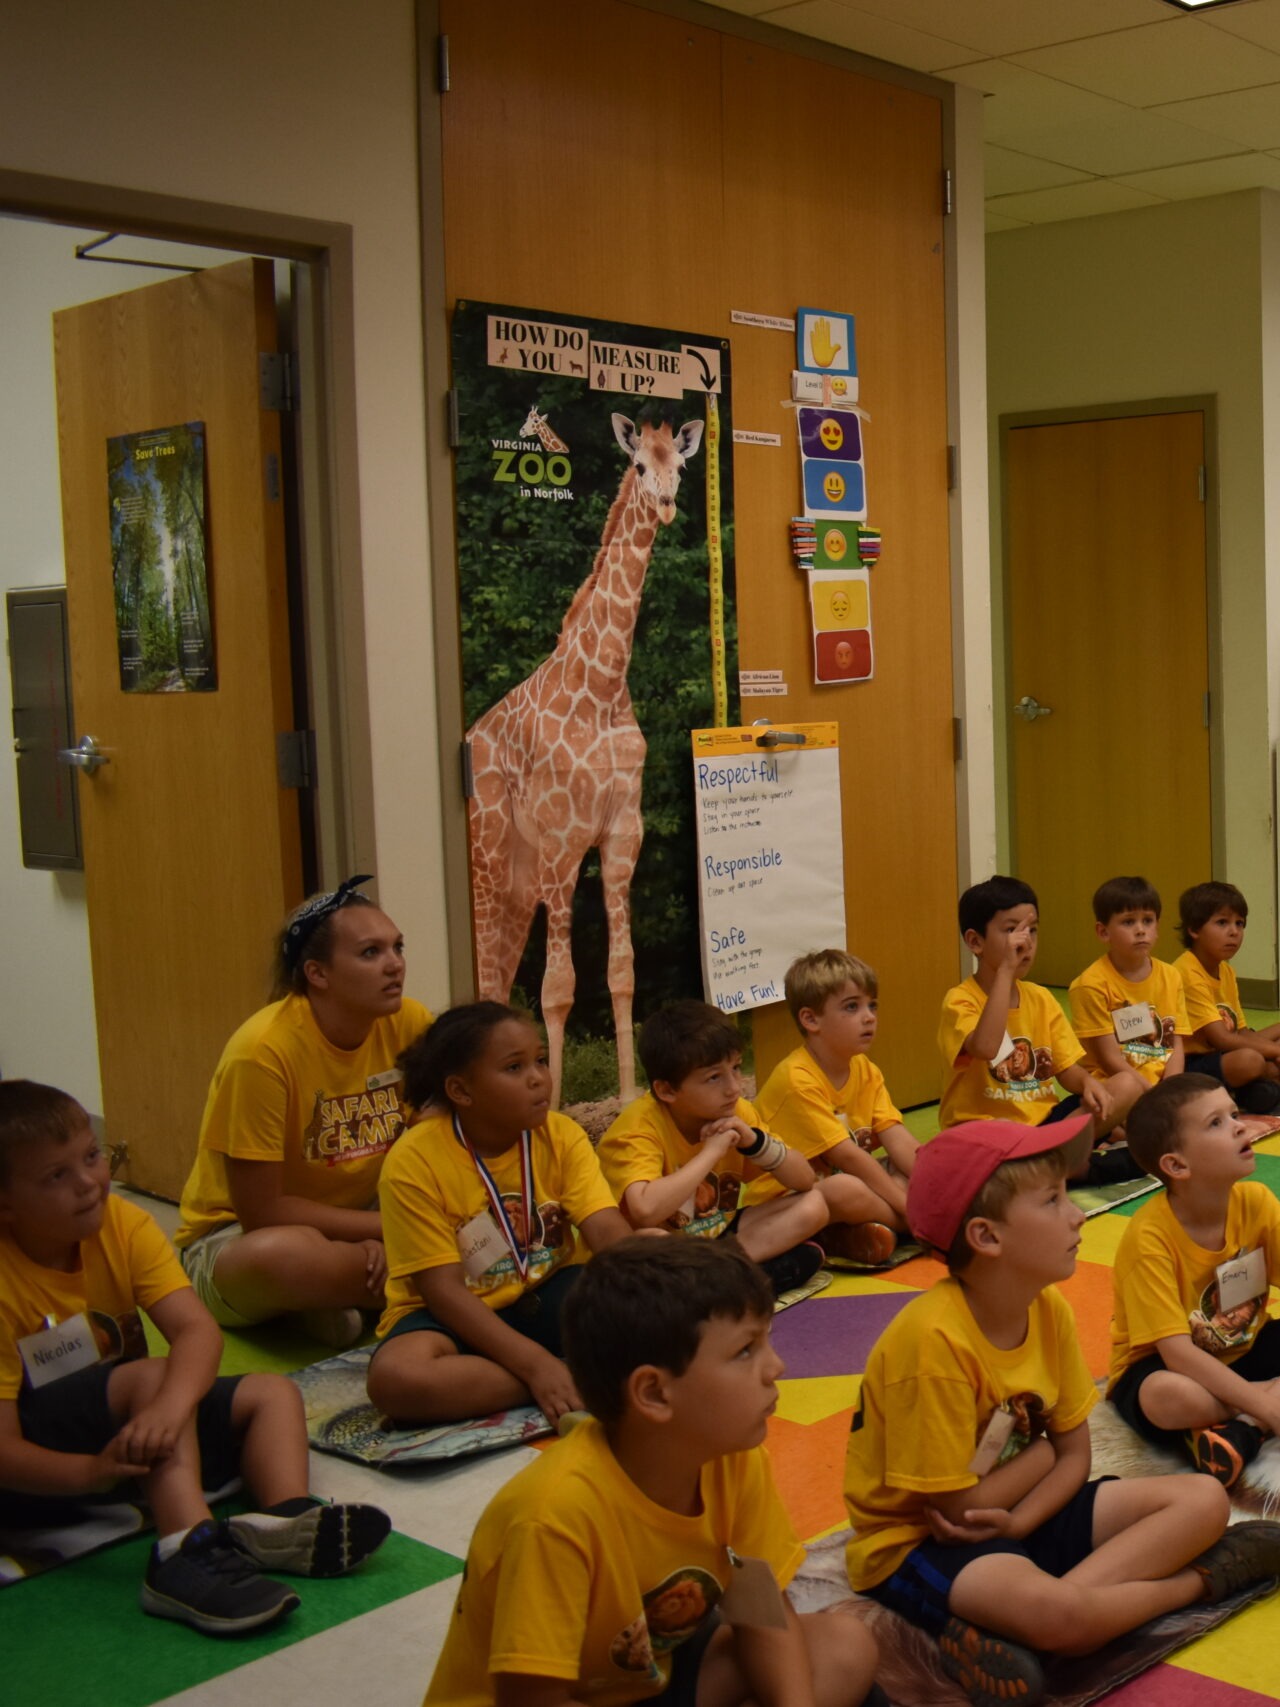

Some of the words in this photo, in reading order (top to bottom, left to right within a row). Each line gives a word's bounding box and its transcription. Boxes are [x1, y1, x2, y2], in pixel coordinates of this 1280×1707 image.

[495, 320, 549, 346] HOW
[553, 328, 584, 351] DO
[518, 348, 562, 372] YOU
[592, 345, 681, 375] MEASURE
[620, 372, 655, 394] UP?
[136, 448, 153, 460] Save
[155, 445, 176, 457] Trees
[491, 439, 543, 452] VIRGINIA
[491, 450, 572, 486] ZOO
[520, 486, 531, 497] in
[534, 487, 574, 502] Norfolk
[698, 759, 778, 793] Respectful
[705, 848, 783, 880] Responsible
[710, 927, 746, 953] Safe
[716, 991, 746, 1010] Have
[750, 980, 779, 1002] Fun!
[1120, 1016, 1143, 1031] Drew
[321, 1087, 399, 1128] SAFARI
[318, 1112, 403, 1155] CAMP
[32, 1337, 83, 1367] Nicolas
